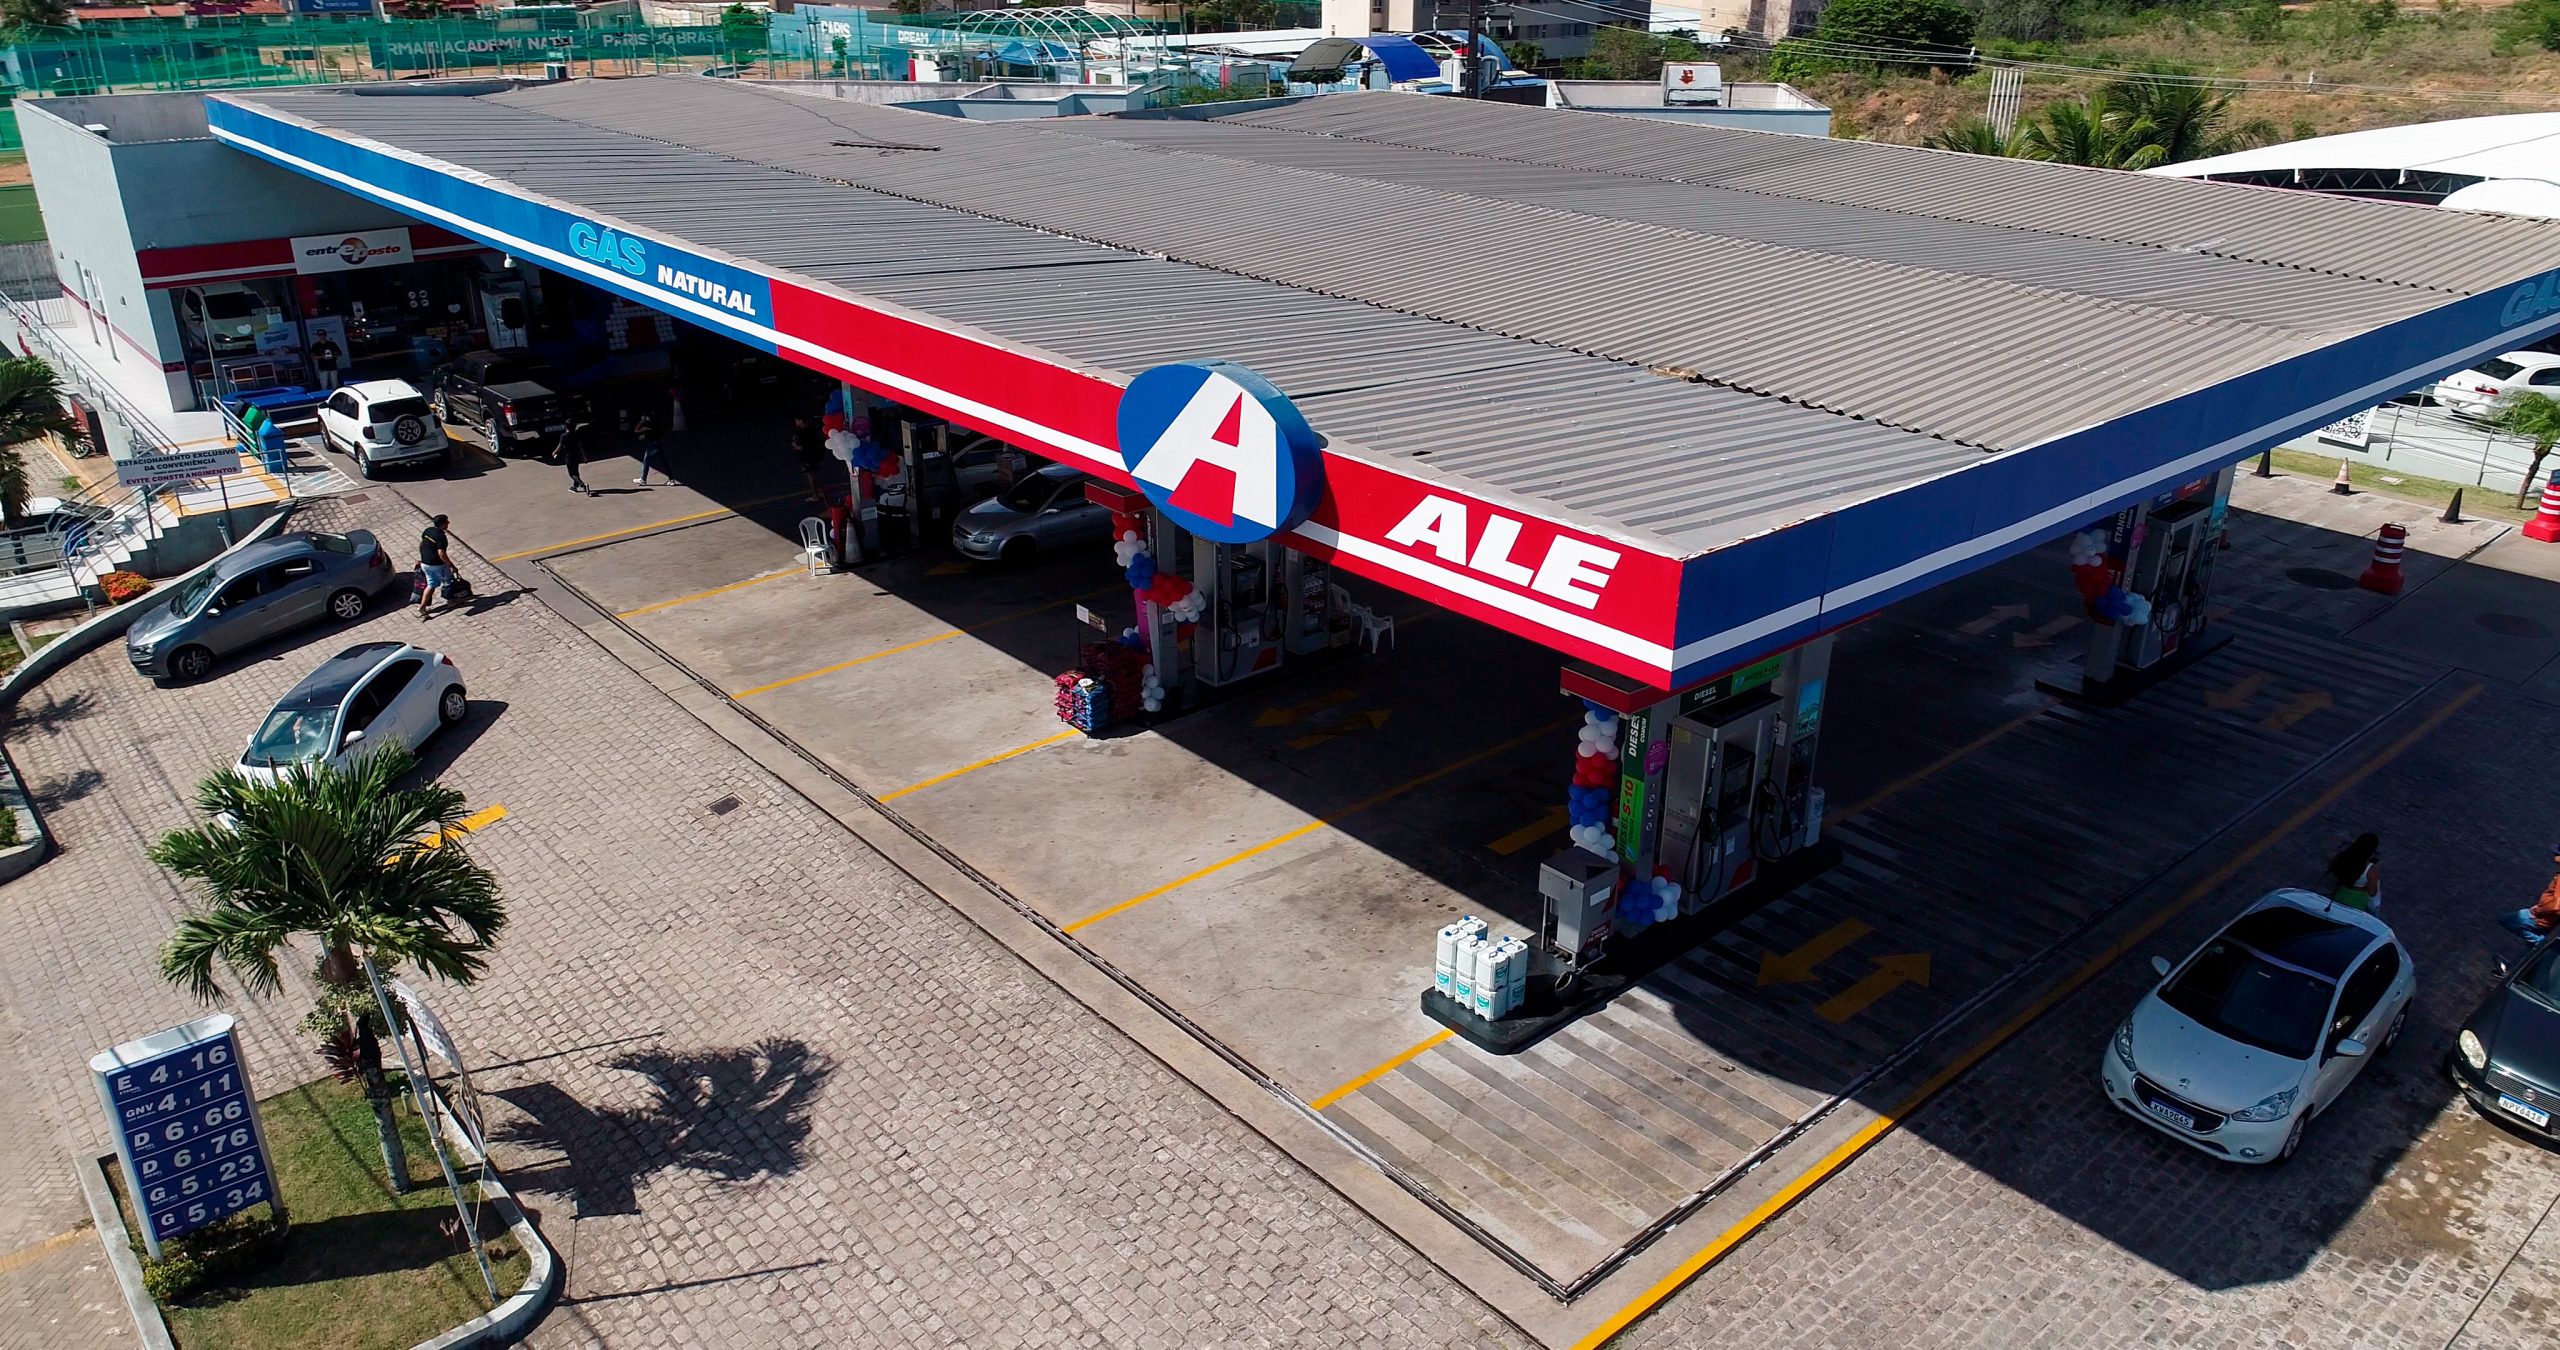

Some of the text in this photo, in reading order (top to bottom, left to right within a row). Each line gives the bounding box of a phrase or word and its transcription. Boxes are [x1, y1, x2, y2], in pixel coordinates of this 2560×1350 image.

[568, 222, 646, 276] GÁS
[657, 264, 756, 316] NATURAL
[2500, 268, 2560, 327] GÁ
[118, 448, 236, 467] ESTACIONAMENTO EXCLUSIVO
[1131, 371, 1277, 529] A
[157, 458, 217, 469] CONVENIÊNCIA
[1384, 494, 1622, 611] ALE
[1693, 686, 1718, 700] DIESEL
[1623, 779, 1634, 816] S-10
[117, 1074, 133, 1091] E
[126, 1102, 154, 1118] GNV
[134, 1132, 150, 1148] D
[142, 1159, 158, 1175] D
[150, 1187, 166, 1202] G
[160, 1213, 175, 1226] G
